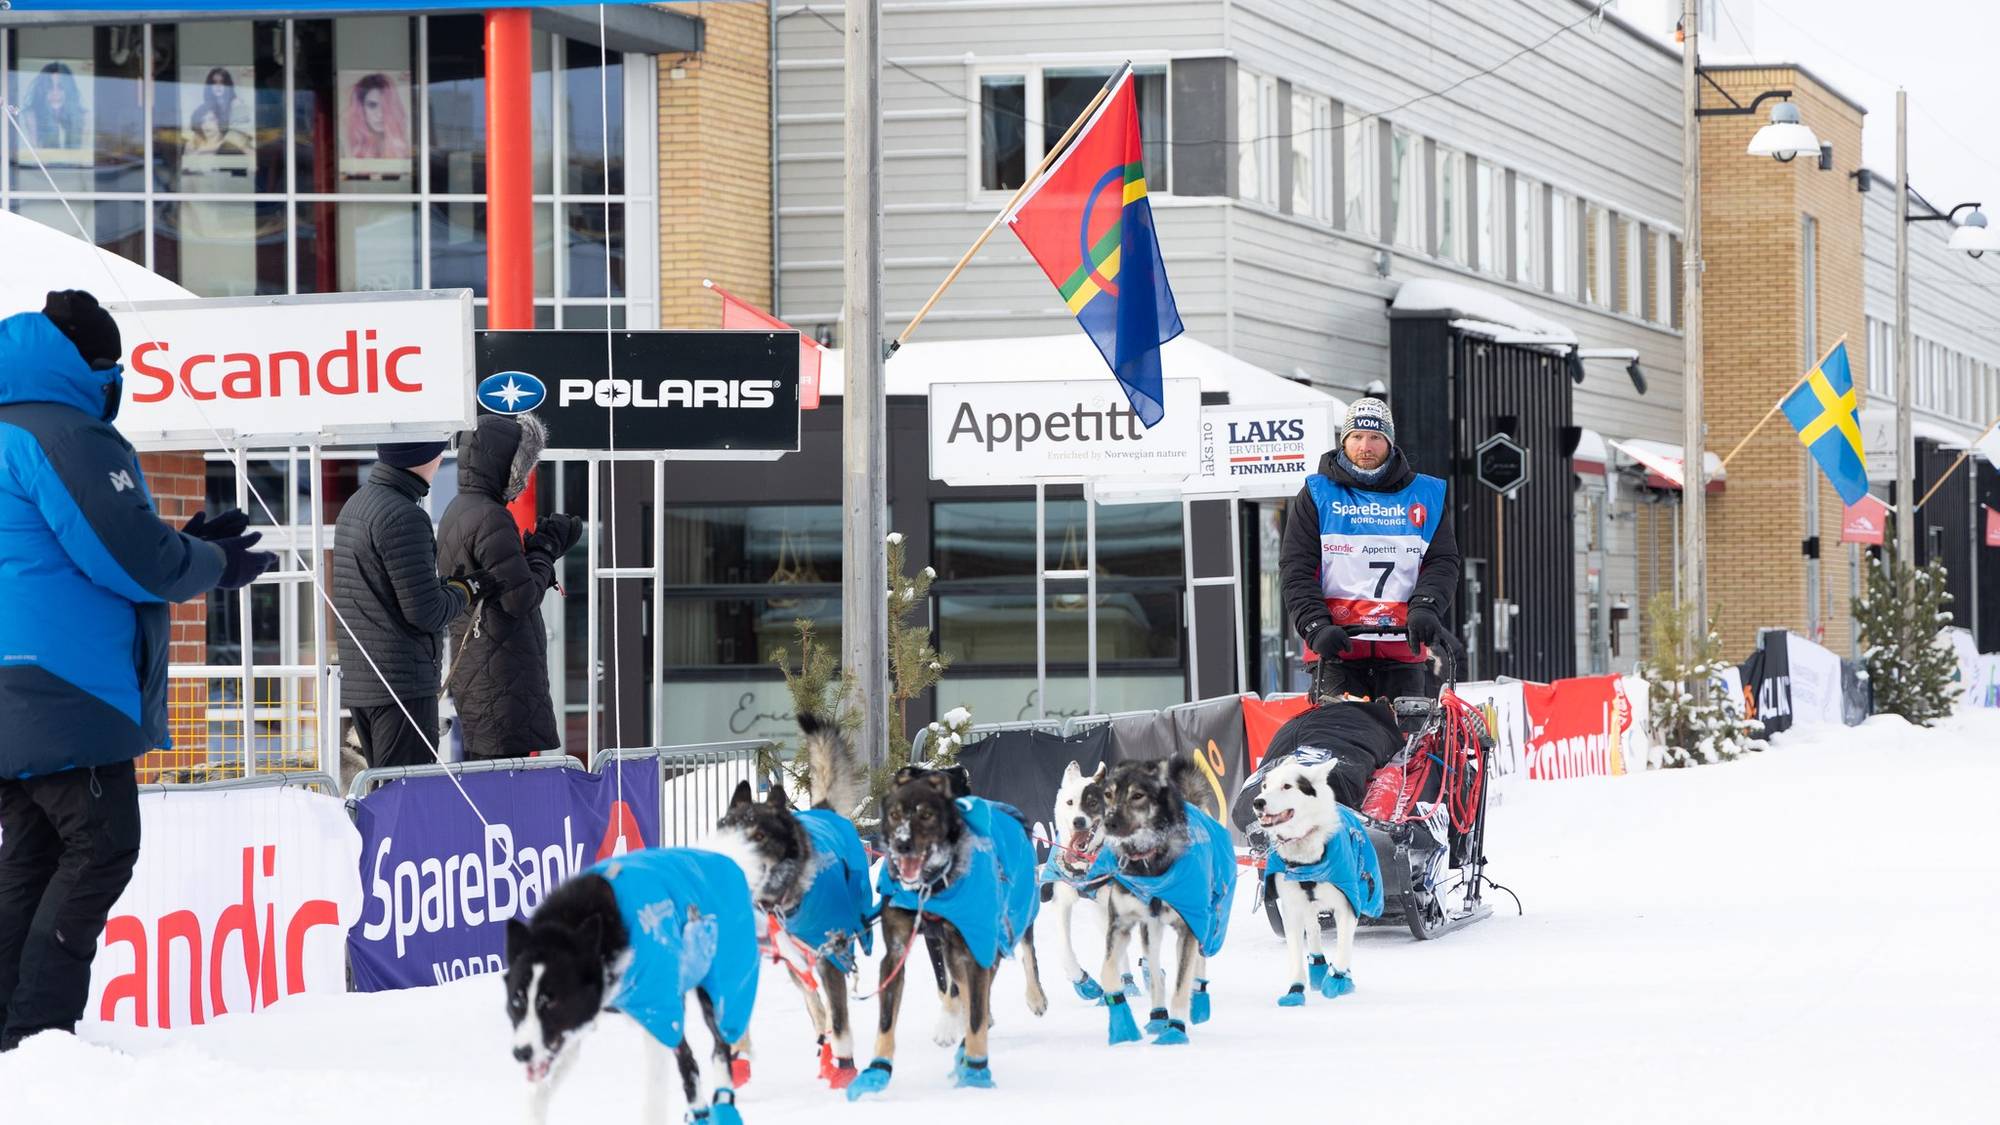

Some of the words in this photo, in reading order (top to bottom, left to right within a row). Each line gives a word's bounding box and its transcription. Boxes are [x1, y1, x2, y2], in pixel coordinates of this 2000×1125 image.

[131, 329, 423, 403] Scandic
[947, 402, 1143, 452] Appetitt
[1228, 418, 1305, 444] LAKS
[1356, 419, 1379, 429] VOM
[1104, 449, 1154, 461] Norwegian
[1156, 449, 1187, 458] nature
[1201, 422, 1215, 477] laks.no
[1229, 445, 1243, 455] ER
[1244, 443, 1281, 454] VIKTIG
[1283, 442, 1305, 452] FOR
[1230, 462, 1306, 476] FINNMARK
[1331, 501, 1406, 517] SpareBank
[1413, 507, 1421, 524] 1
[1350, 517, 1407, 526] NORD-NORGE
[1323, 543, 1354, 553] Scandic
[1361, 545, 1397, 554] Appetitt
[1368, 561, 1396, 599] 7
[100, 845, 340, 1030] andic
